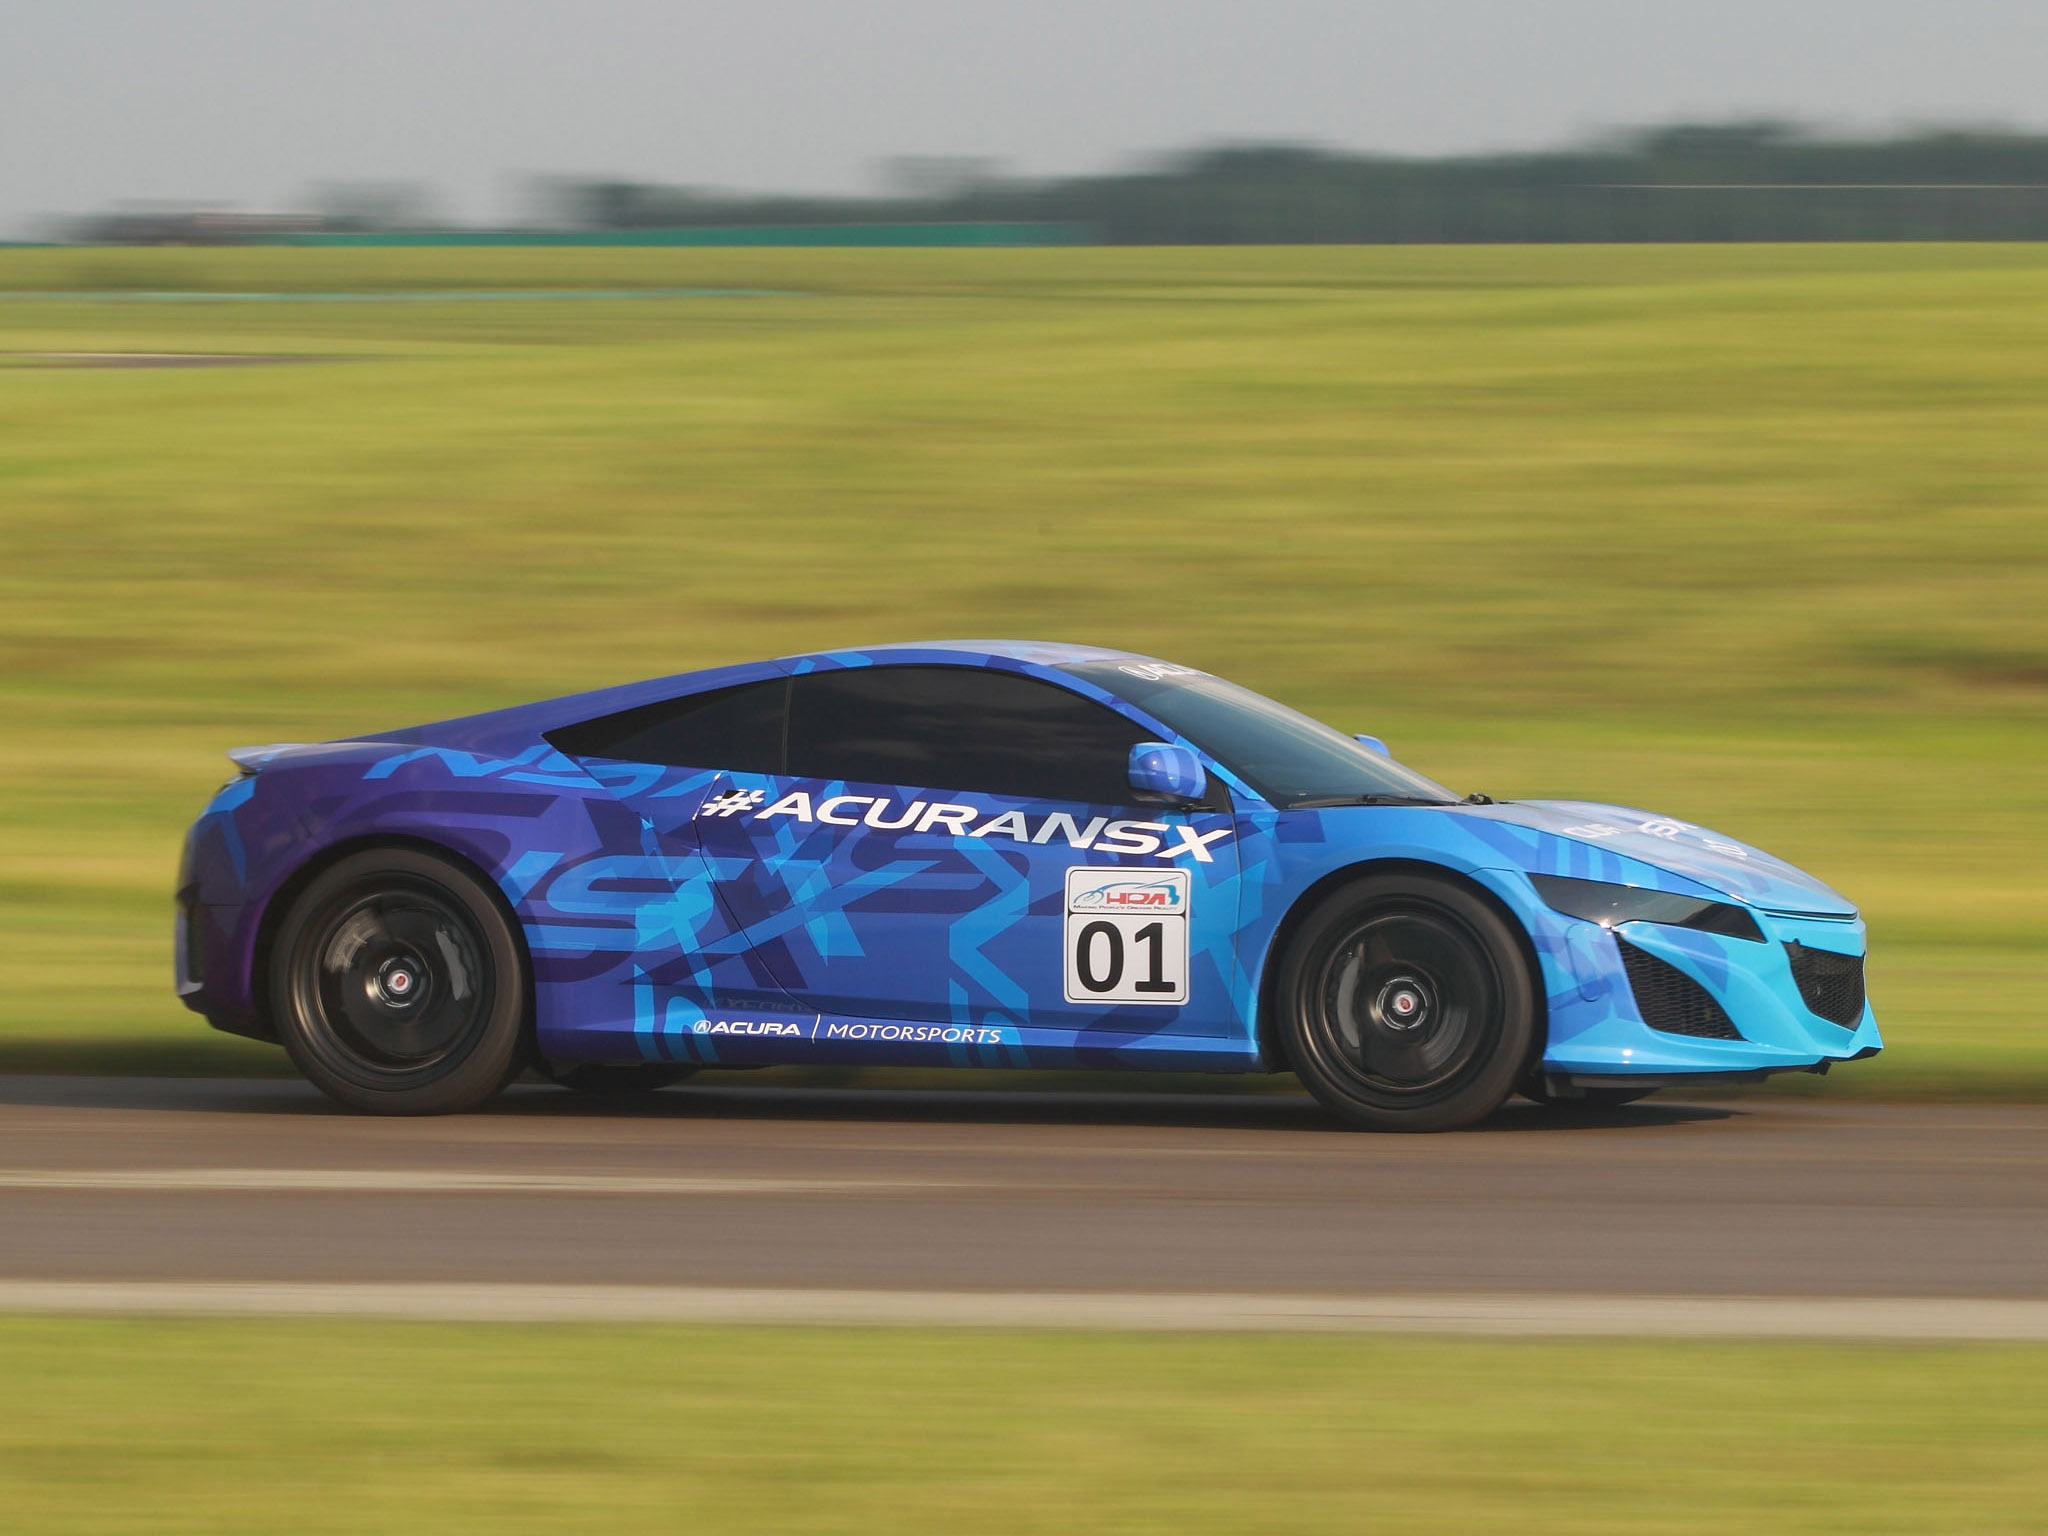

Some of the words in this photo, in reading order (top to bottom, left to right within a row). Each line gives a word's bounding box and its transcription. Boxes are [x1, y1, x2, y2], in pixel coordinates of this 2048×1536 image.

[702, 789, 1233, 863] #ACURANSX
[1076, 920, 1176, 993] 01
[710, 1021, 800, 1036] ACURA
[827, 1024, 1001, 1044] MOTORSPORTS
